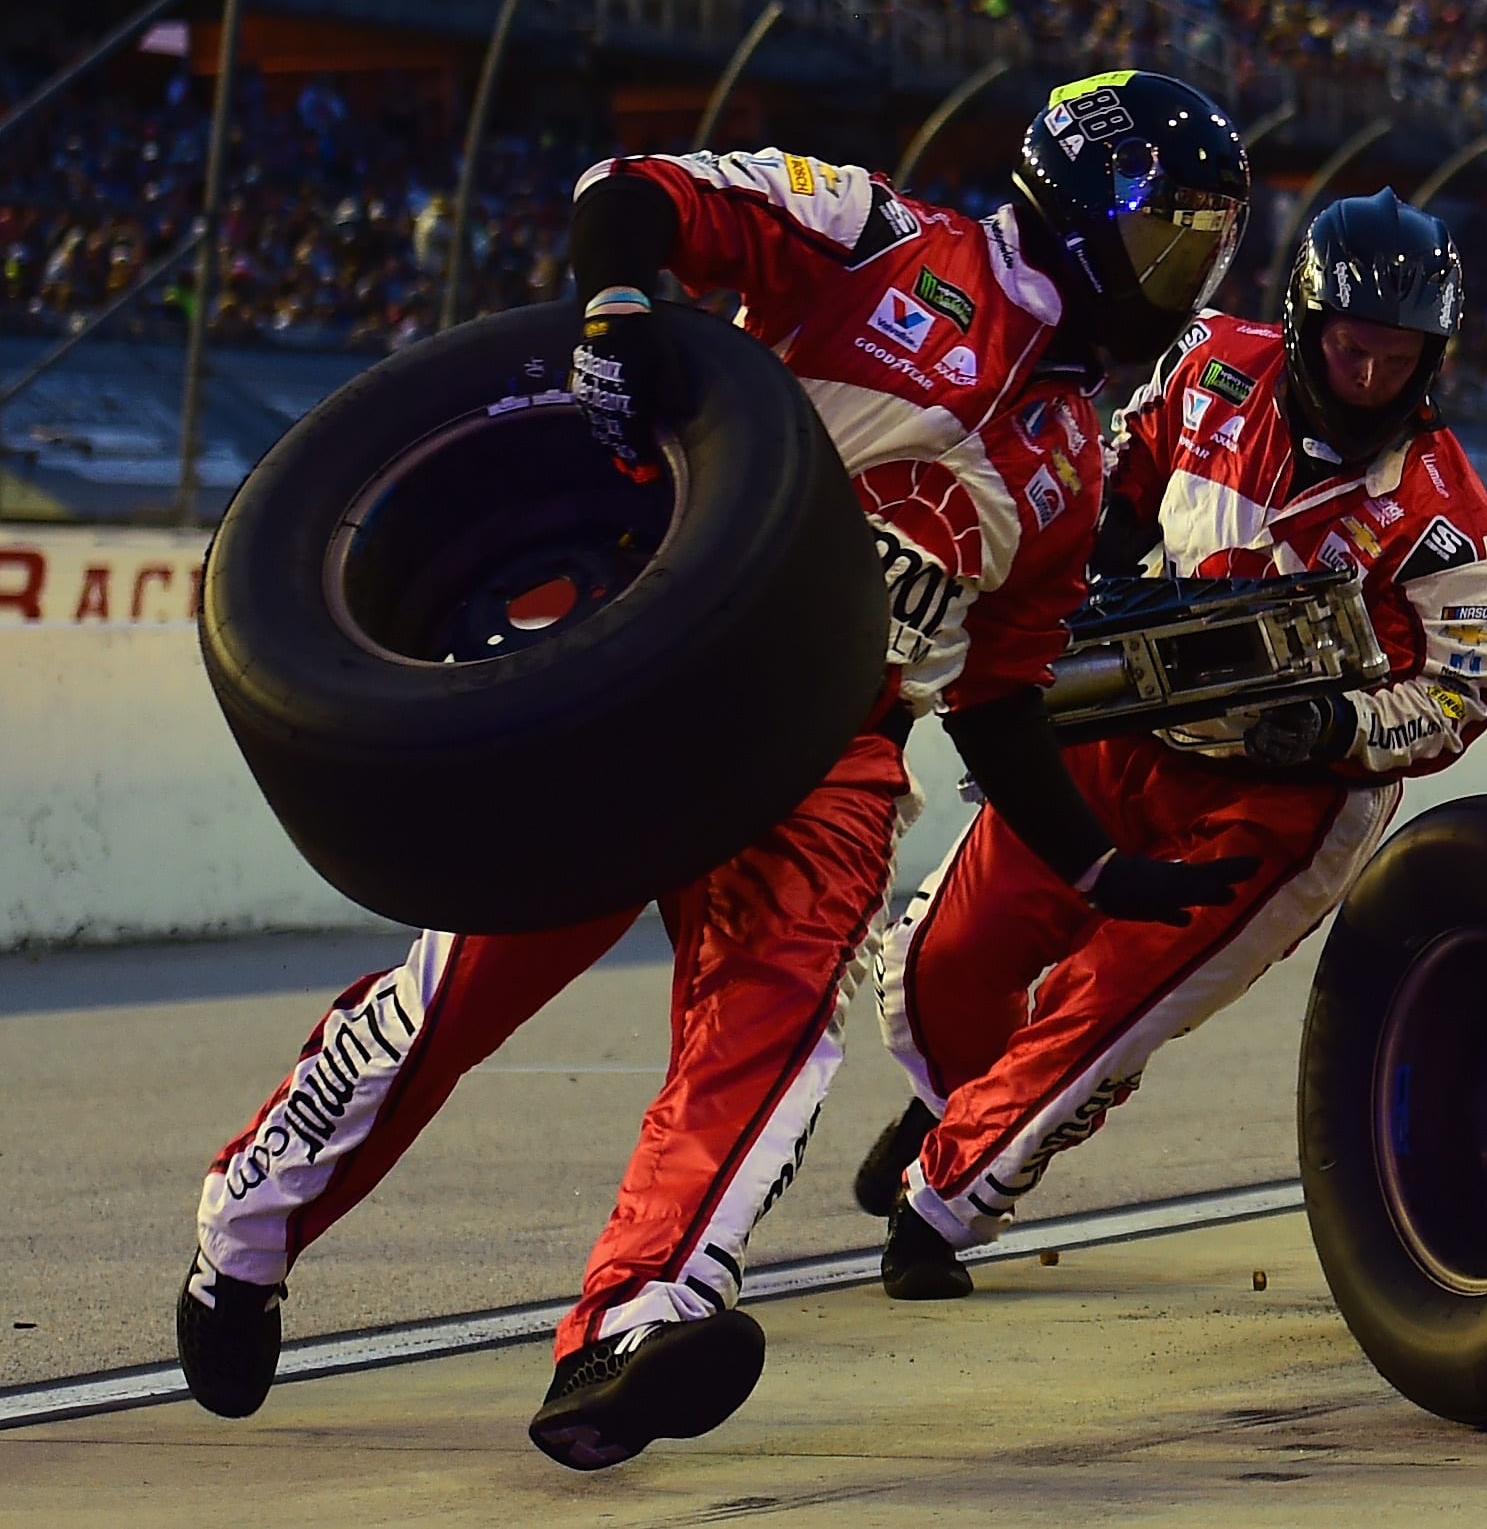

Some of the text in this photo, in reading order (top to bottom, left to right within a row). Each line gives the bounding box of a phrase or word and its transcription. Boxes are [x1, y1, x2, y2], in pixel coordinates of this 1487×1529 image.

[1066, 88, 1135, 142] 88
[854, 337, 935, 391] GOODYEAR
[1430, 687, 1466, 720] SUNOC
